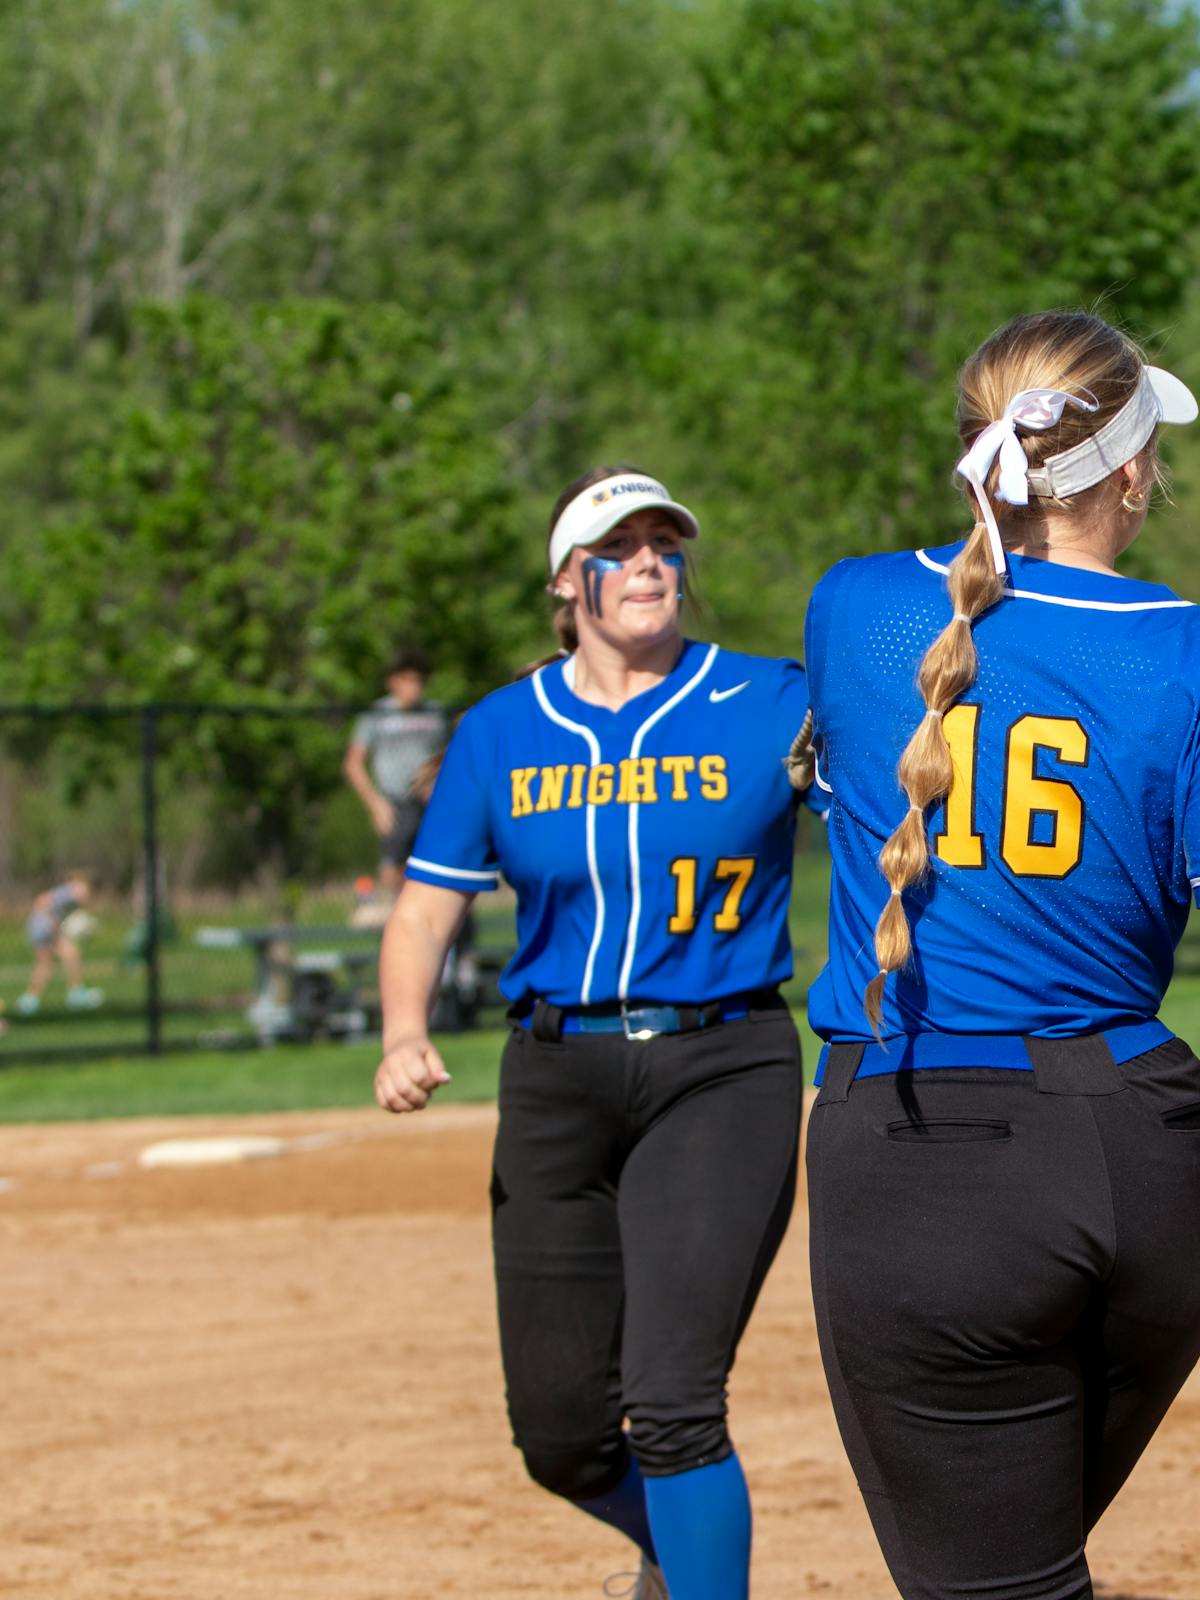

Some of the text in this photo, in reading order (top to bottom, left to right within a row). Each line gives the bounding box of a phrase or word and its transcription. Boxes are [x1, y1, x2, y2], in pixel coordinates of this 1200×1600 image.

[510, 754, 729, 818] KNIGHTS
[933, 702, 1090, 881] 16
[667, 856, 756, 934] 17
